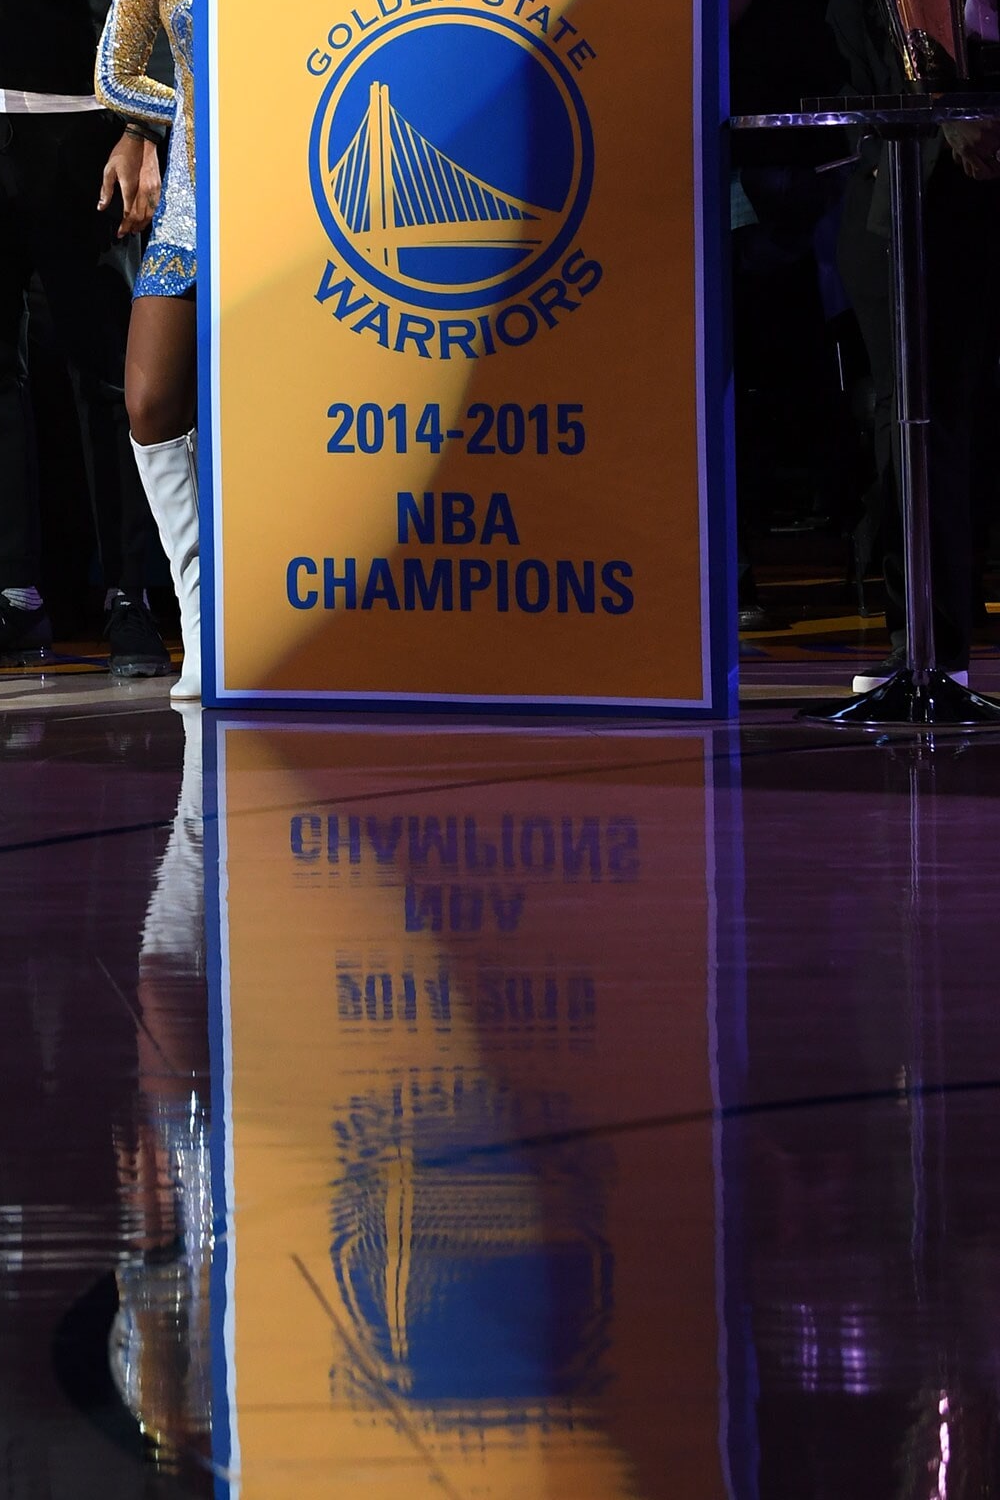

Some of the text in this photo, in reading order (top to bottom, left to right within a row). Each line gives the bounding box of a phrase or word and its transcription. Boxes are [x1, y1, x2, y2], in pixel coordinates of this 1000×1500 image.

[314, 248, 603, 360] WARRIORS
[327, 402, 586, 456] 2014-2015
[397, 491, 520, 545] NBA
[286, 556, 635, 615] CHAMPIONS
